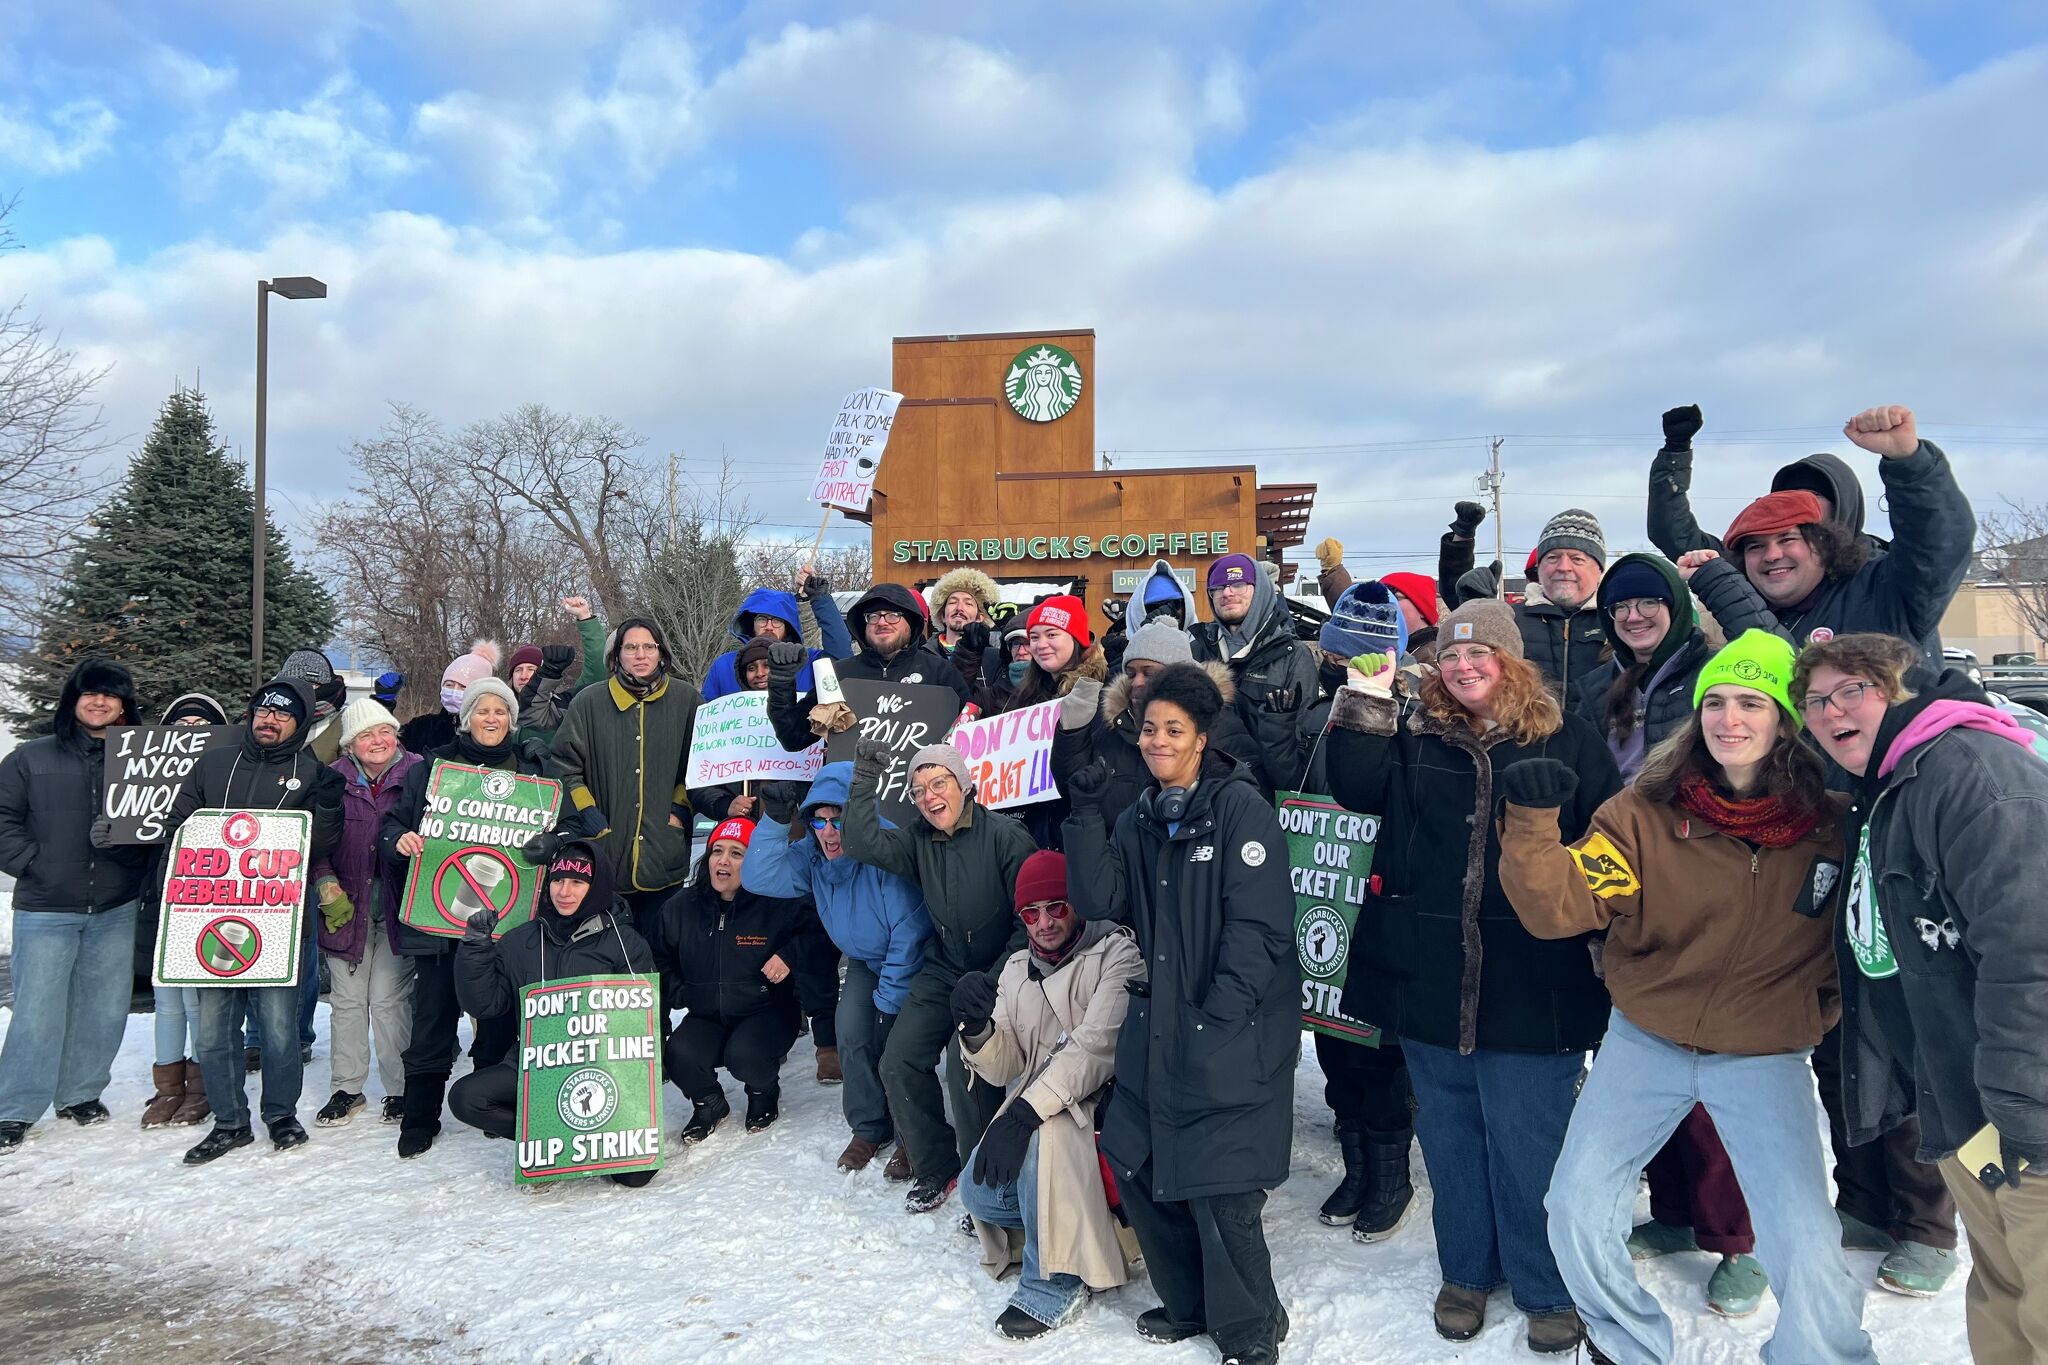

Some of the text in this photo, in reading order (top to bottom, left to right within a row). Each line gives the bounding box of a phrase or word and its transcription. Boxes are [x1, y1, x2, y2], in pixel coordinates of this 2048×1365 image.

[843, 391, 890, 410] DON'T
[835, 412, 861, 429] TALK
[829, 431, 853, 444] UNTIL
[824, 445, 862, 460] HAD MY
[820, 460, 848, 478] FIRST
[814, 480, 869, 505] CONTRACT
[893, 531, 1230, 563] STARBUCKS COFFEE
[698, 696, 768, 719] THE MONEY
[696, 716, 770, 738] YOUR NAME BUT
[954, 709, 1027, 760] DON'T
[116, 729, 212, 758] I LIKE
[746, 734, 778, 748] DID
[708, 759, 752, 780] MISTER
[977, 758, 1027, 806] PICKET
[425, 794, 453, 814] NO
[418, 817, 444, 838] NO
[1278, 807, 1381, 844] DON'T CRO
[175, 848, 302, 879] RED CUP
[1313, 841, 1351, 869] OUR
[166, 878, 303, 906] REBELLION
[1289, 866, 1369, 905] CKET LI
[1305, 910, 1343, 933] STARBUCKS
[1299, 936, 1318, 972] WORKERS
[1325, 944, 1345, 972] UNITED
[525, 987, 653, 1019] DON'T CROSS
[566, 1013, 608, 1037] OUR
[522, 1035, 655, 1071] PICKET LINE
[567, 1071, 610, 1091] STARBUCKS
[560, 1100, 589, 1127] WORKERS
[594, 1095, 615, 1123] UNITED
[518, 1127, 660, 1169] ULP STRIKE
